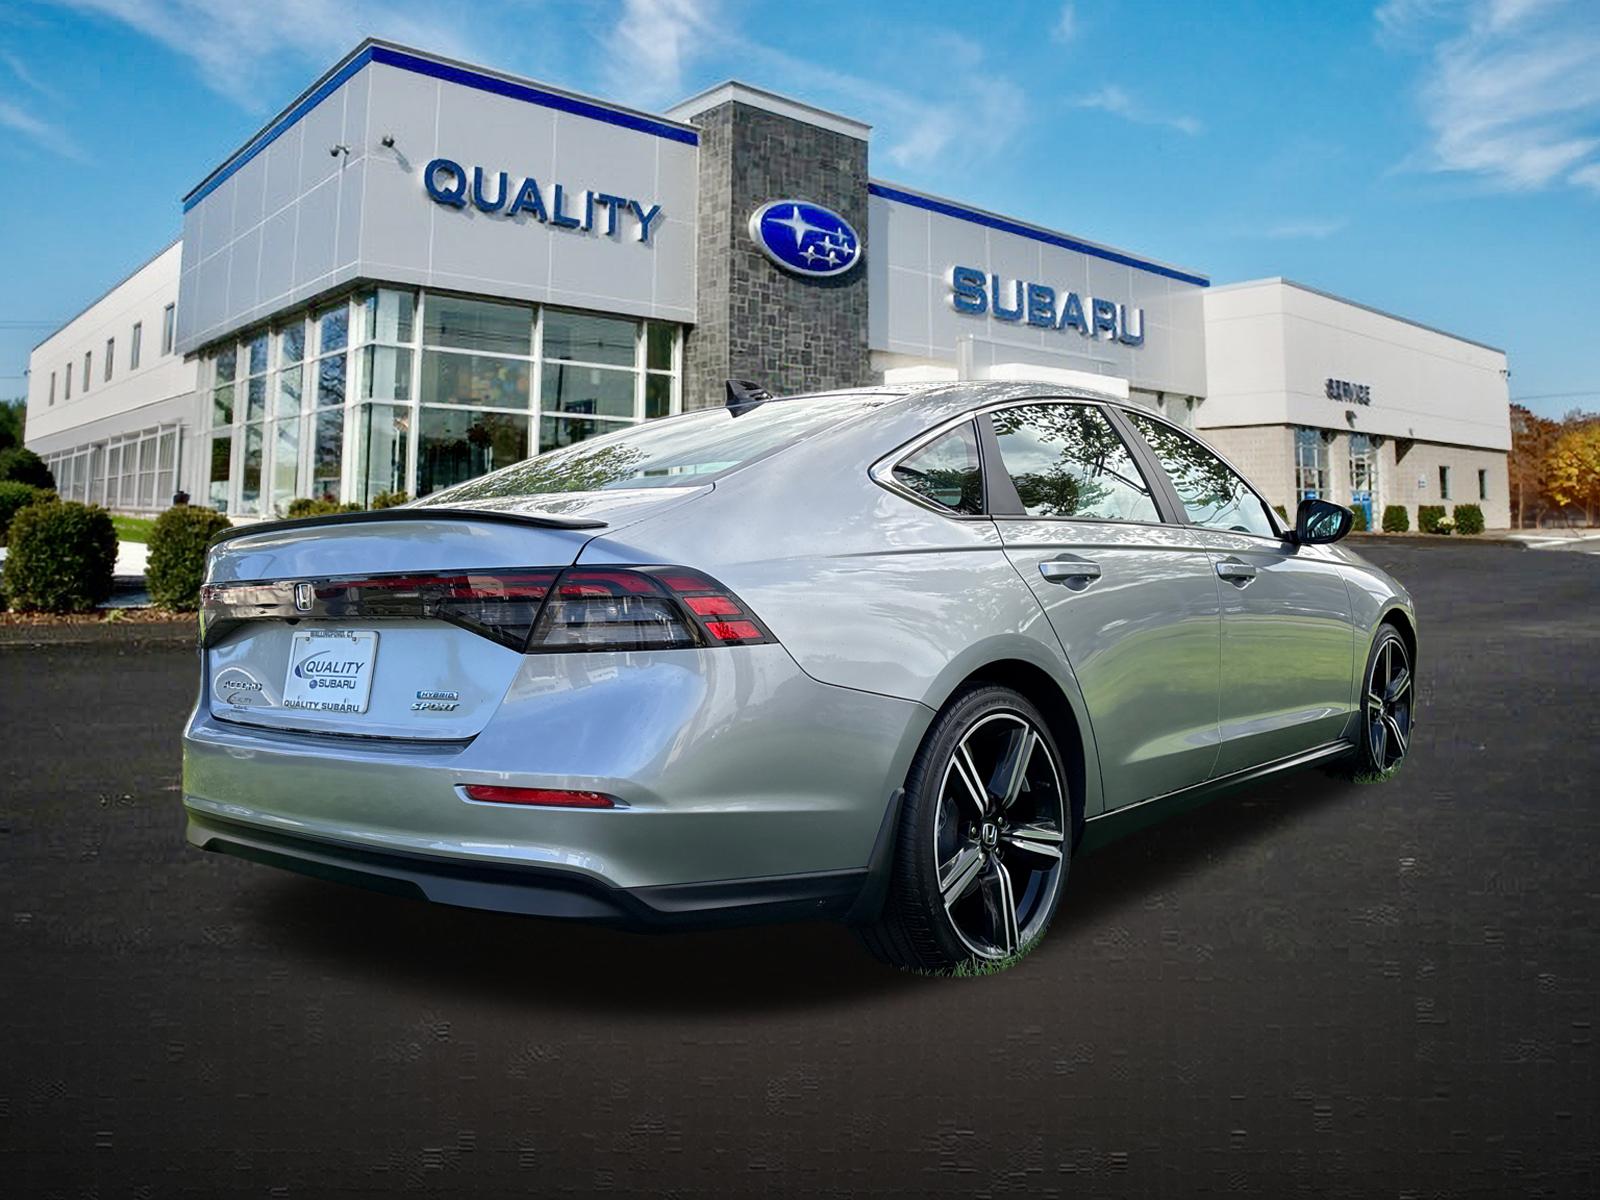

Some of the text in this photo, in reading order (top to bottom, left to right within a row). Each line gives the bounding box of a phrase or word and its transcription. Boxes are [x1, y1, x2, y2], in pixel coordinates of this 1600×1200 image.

[424, 158, 662, 243] QUALITY
[947, 265, 1145, 347] SUBARU
[306, 661, 365, 674] QUALITY
[318, 679, 356, 689] SUBARU
[284, 700, 360, 713] QUALITY SUBARU
[410, 702, 460, 711] SPORT
